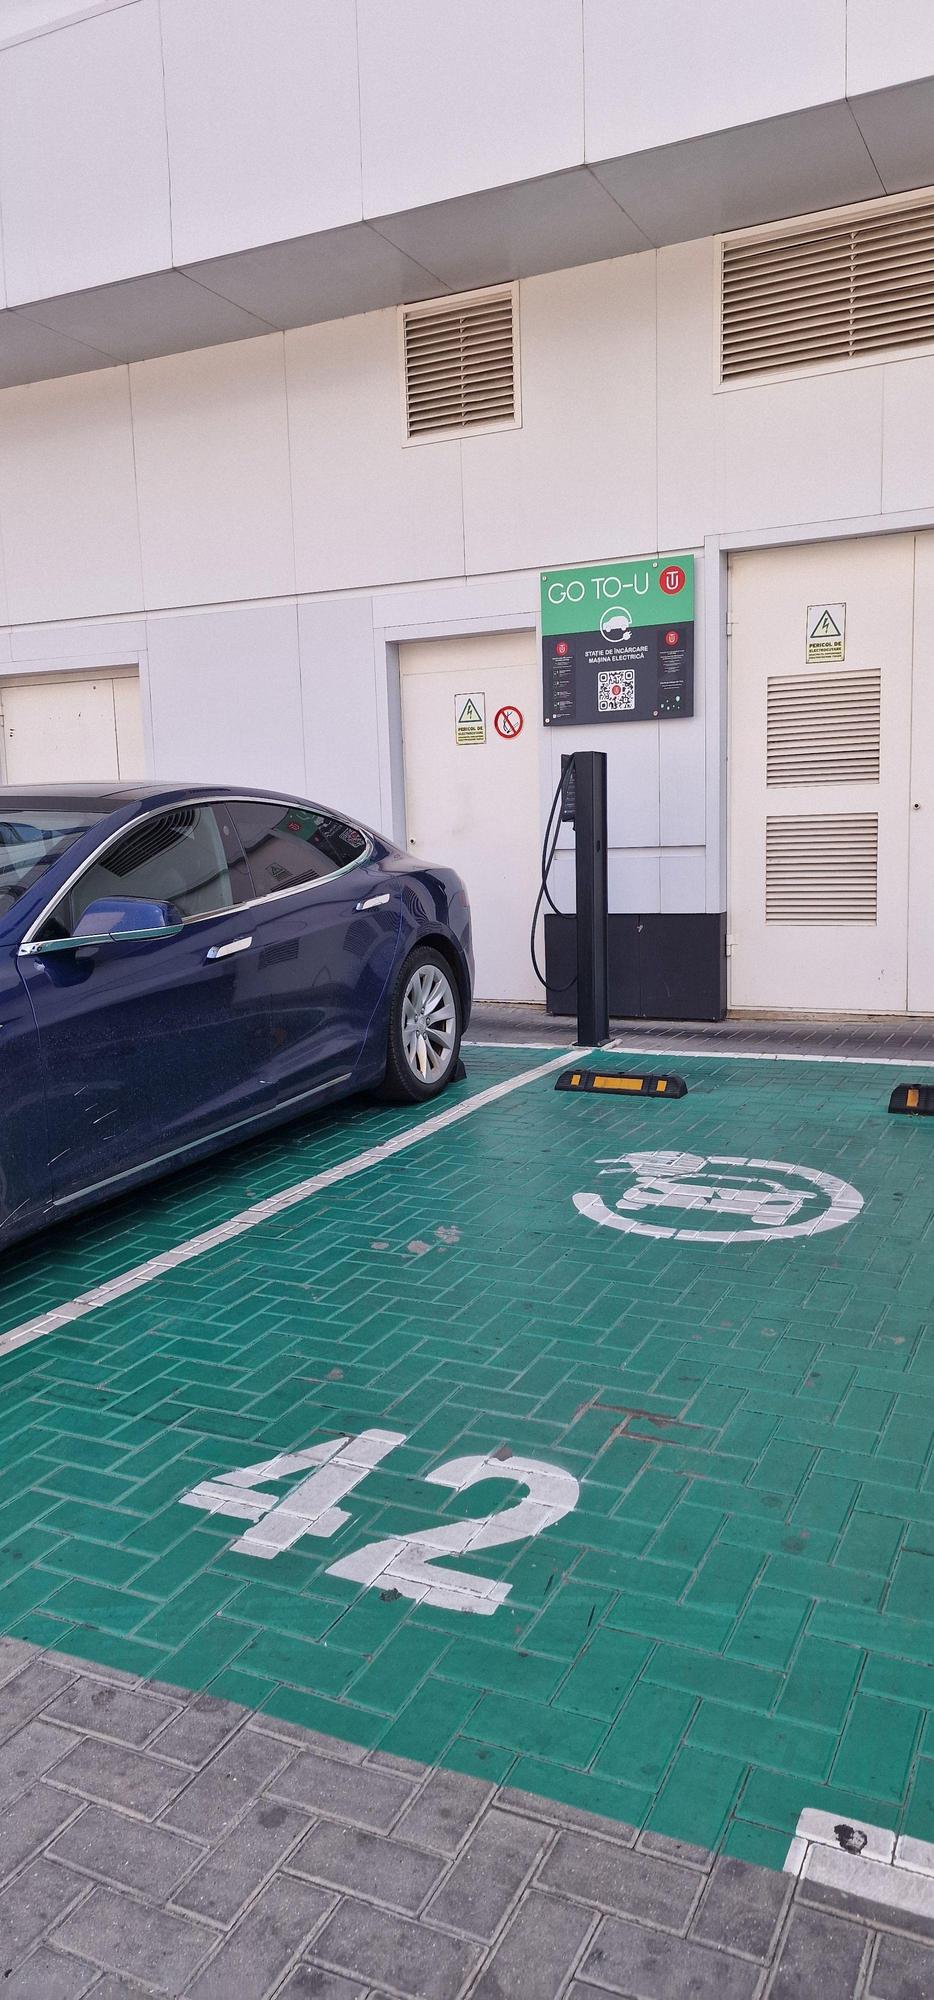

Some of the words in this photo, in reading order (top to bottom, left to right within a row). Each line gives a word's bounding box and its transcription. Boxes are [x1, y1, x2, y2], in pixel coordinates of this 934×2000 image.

[548, 581, 585, 604] GO
[591, 572, 649, 600] TO-U
[179, 1428, 580, 1616] 42
